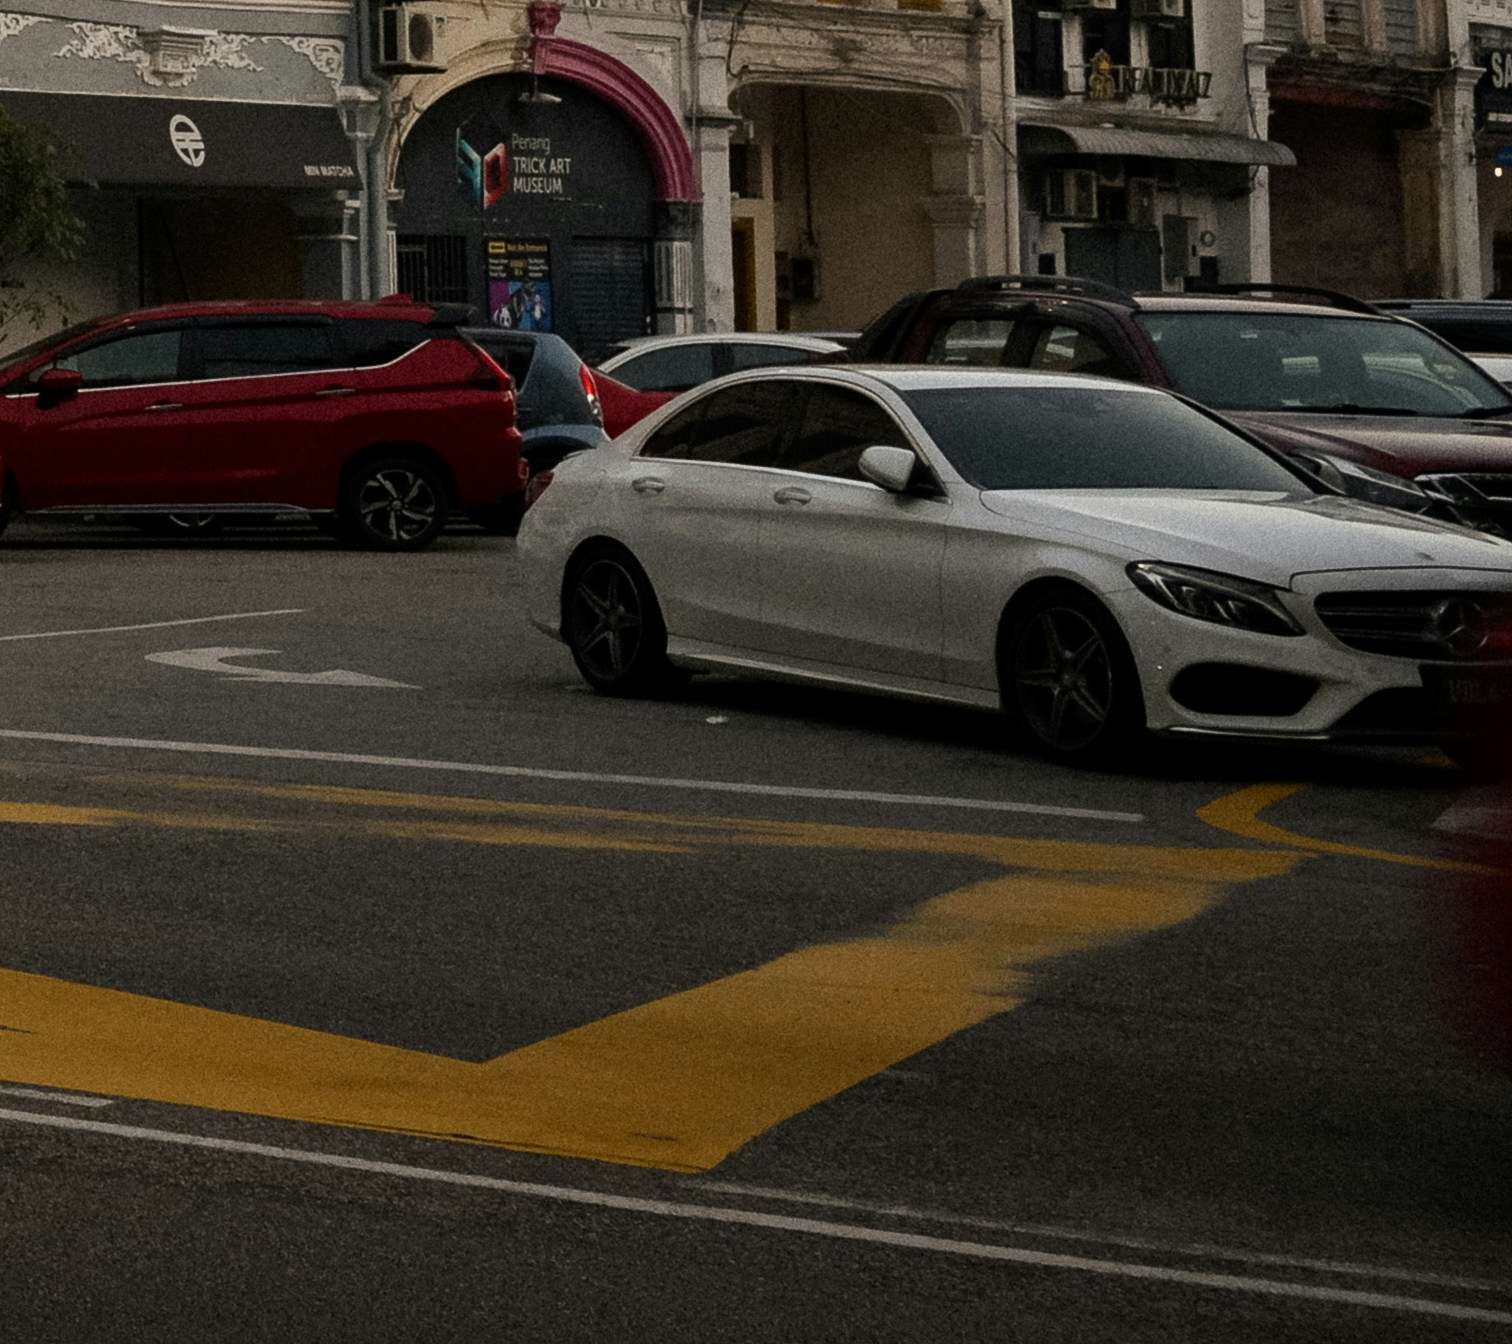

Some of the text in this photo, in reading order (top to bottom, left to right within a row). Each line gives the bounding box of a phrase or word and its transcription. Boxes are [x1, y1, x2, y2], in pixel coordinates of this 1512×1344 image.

[511, 133, 552, 155] Penang
[513, 157, 572, 174] TRICK ART
[513, 177, 563, 194] MUSEUM
